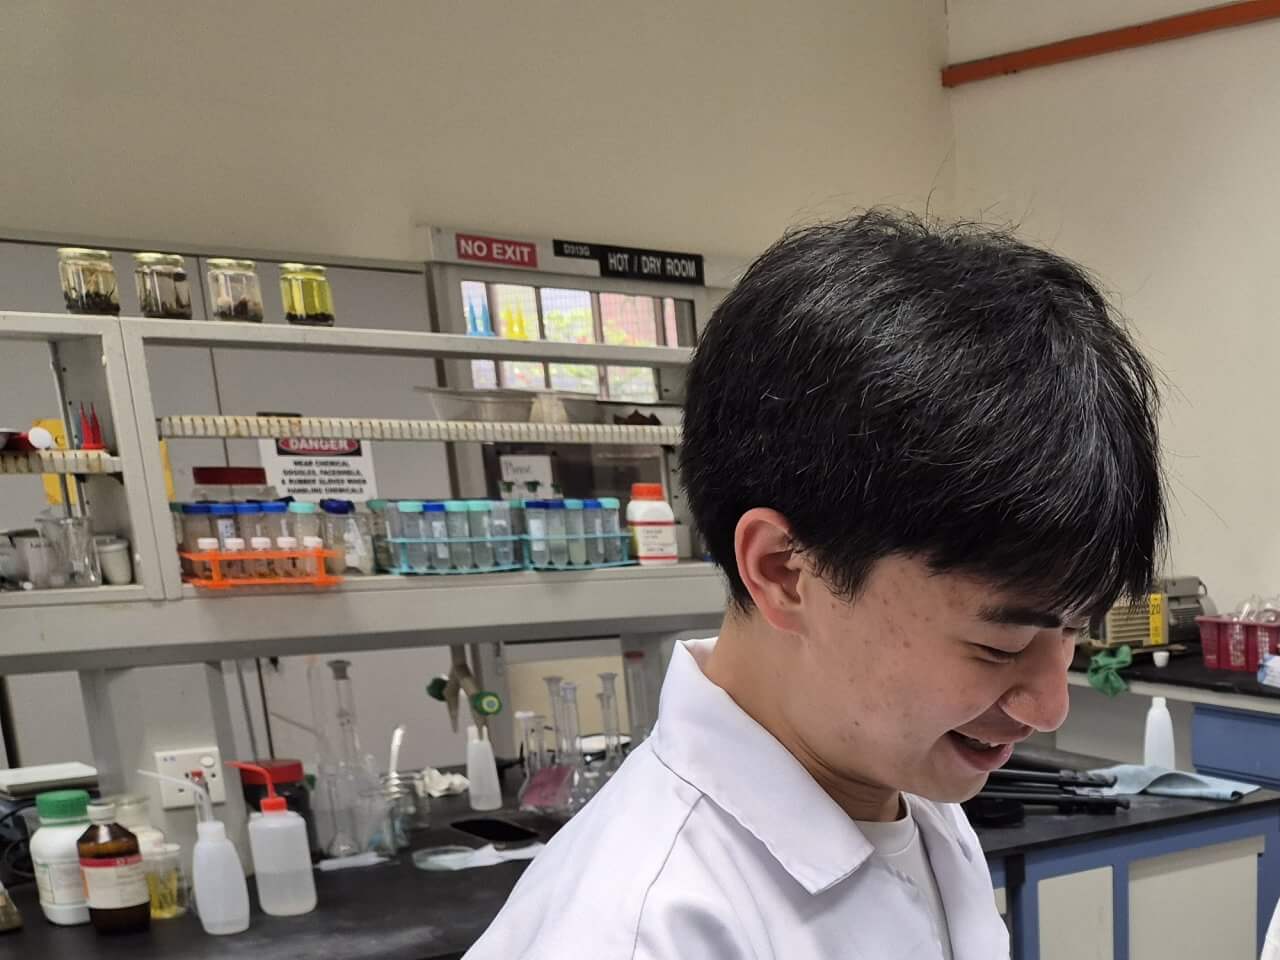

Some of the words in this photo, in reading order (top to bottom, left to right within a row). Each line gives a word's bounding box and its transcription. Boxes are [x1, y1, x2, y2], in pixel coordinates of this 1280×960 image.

[460, 239, 487, 257] NO
[492, 242, 531, 263] EXIT
[608, 253, 629, 271] HOT
[641, 255, 662, 275] DRY
[666, 259, 697, 278] ROOM
[289, 438, 349, 450] DANGER
